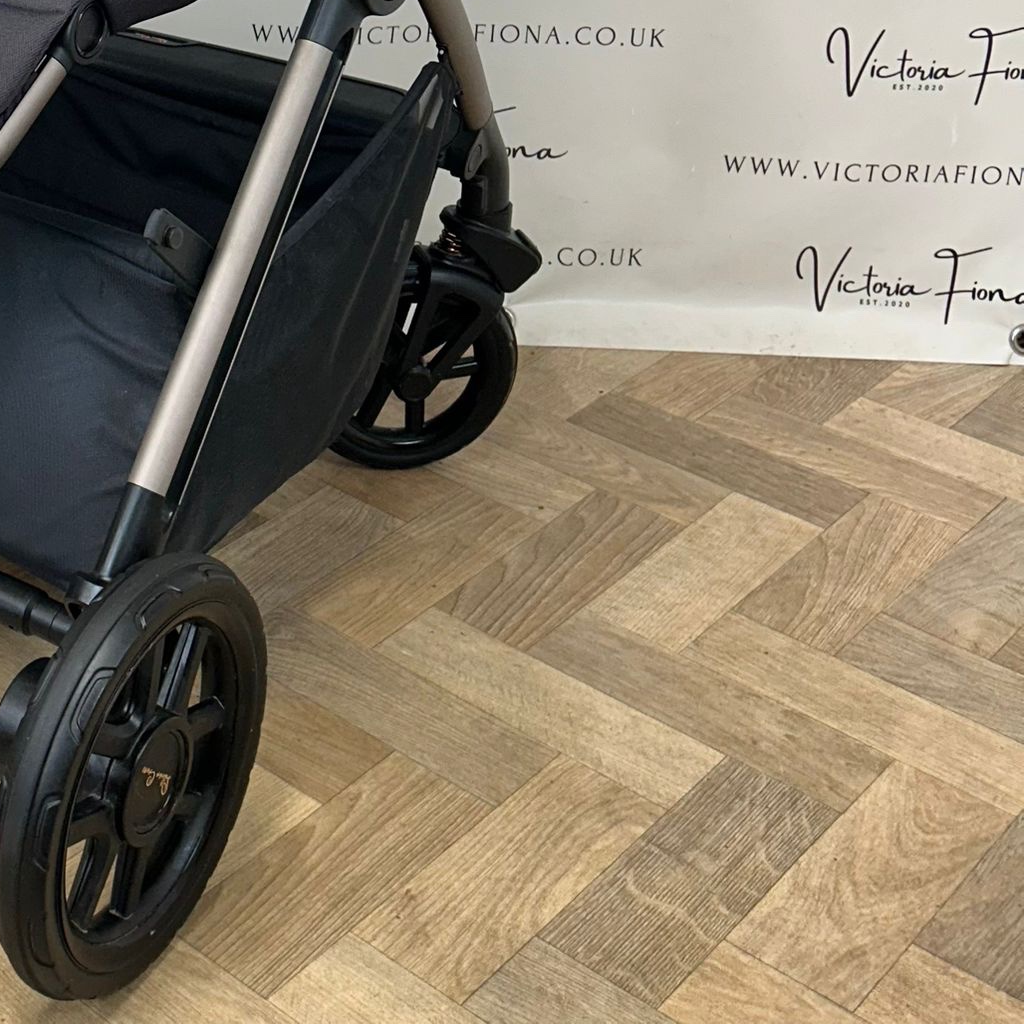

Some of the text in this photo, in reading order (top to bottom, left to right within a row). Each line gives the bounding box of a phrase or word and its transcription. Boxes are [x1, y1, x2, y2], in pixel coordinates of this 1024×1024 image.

[826, 27, 965, 97] Victoria
[892, 83, 944, 91] EST.2020
[796, 245, 932, 312] Victoria
[859, 298, 910, 308] EST.2020
